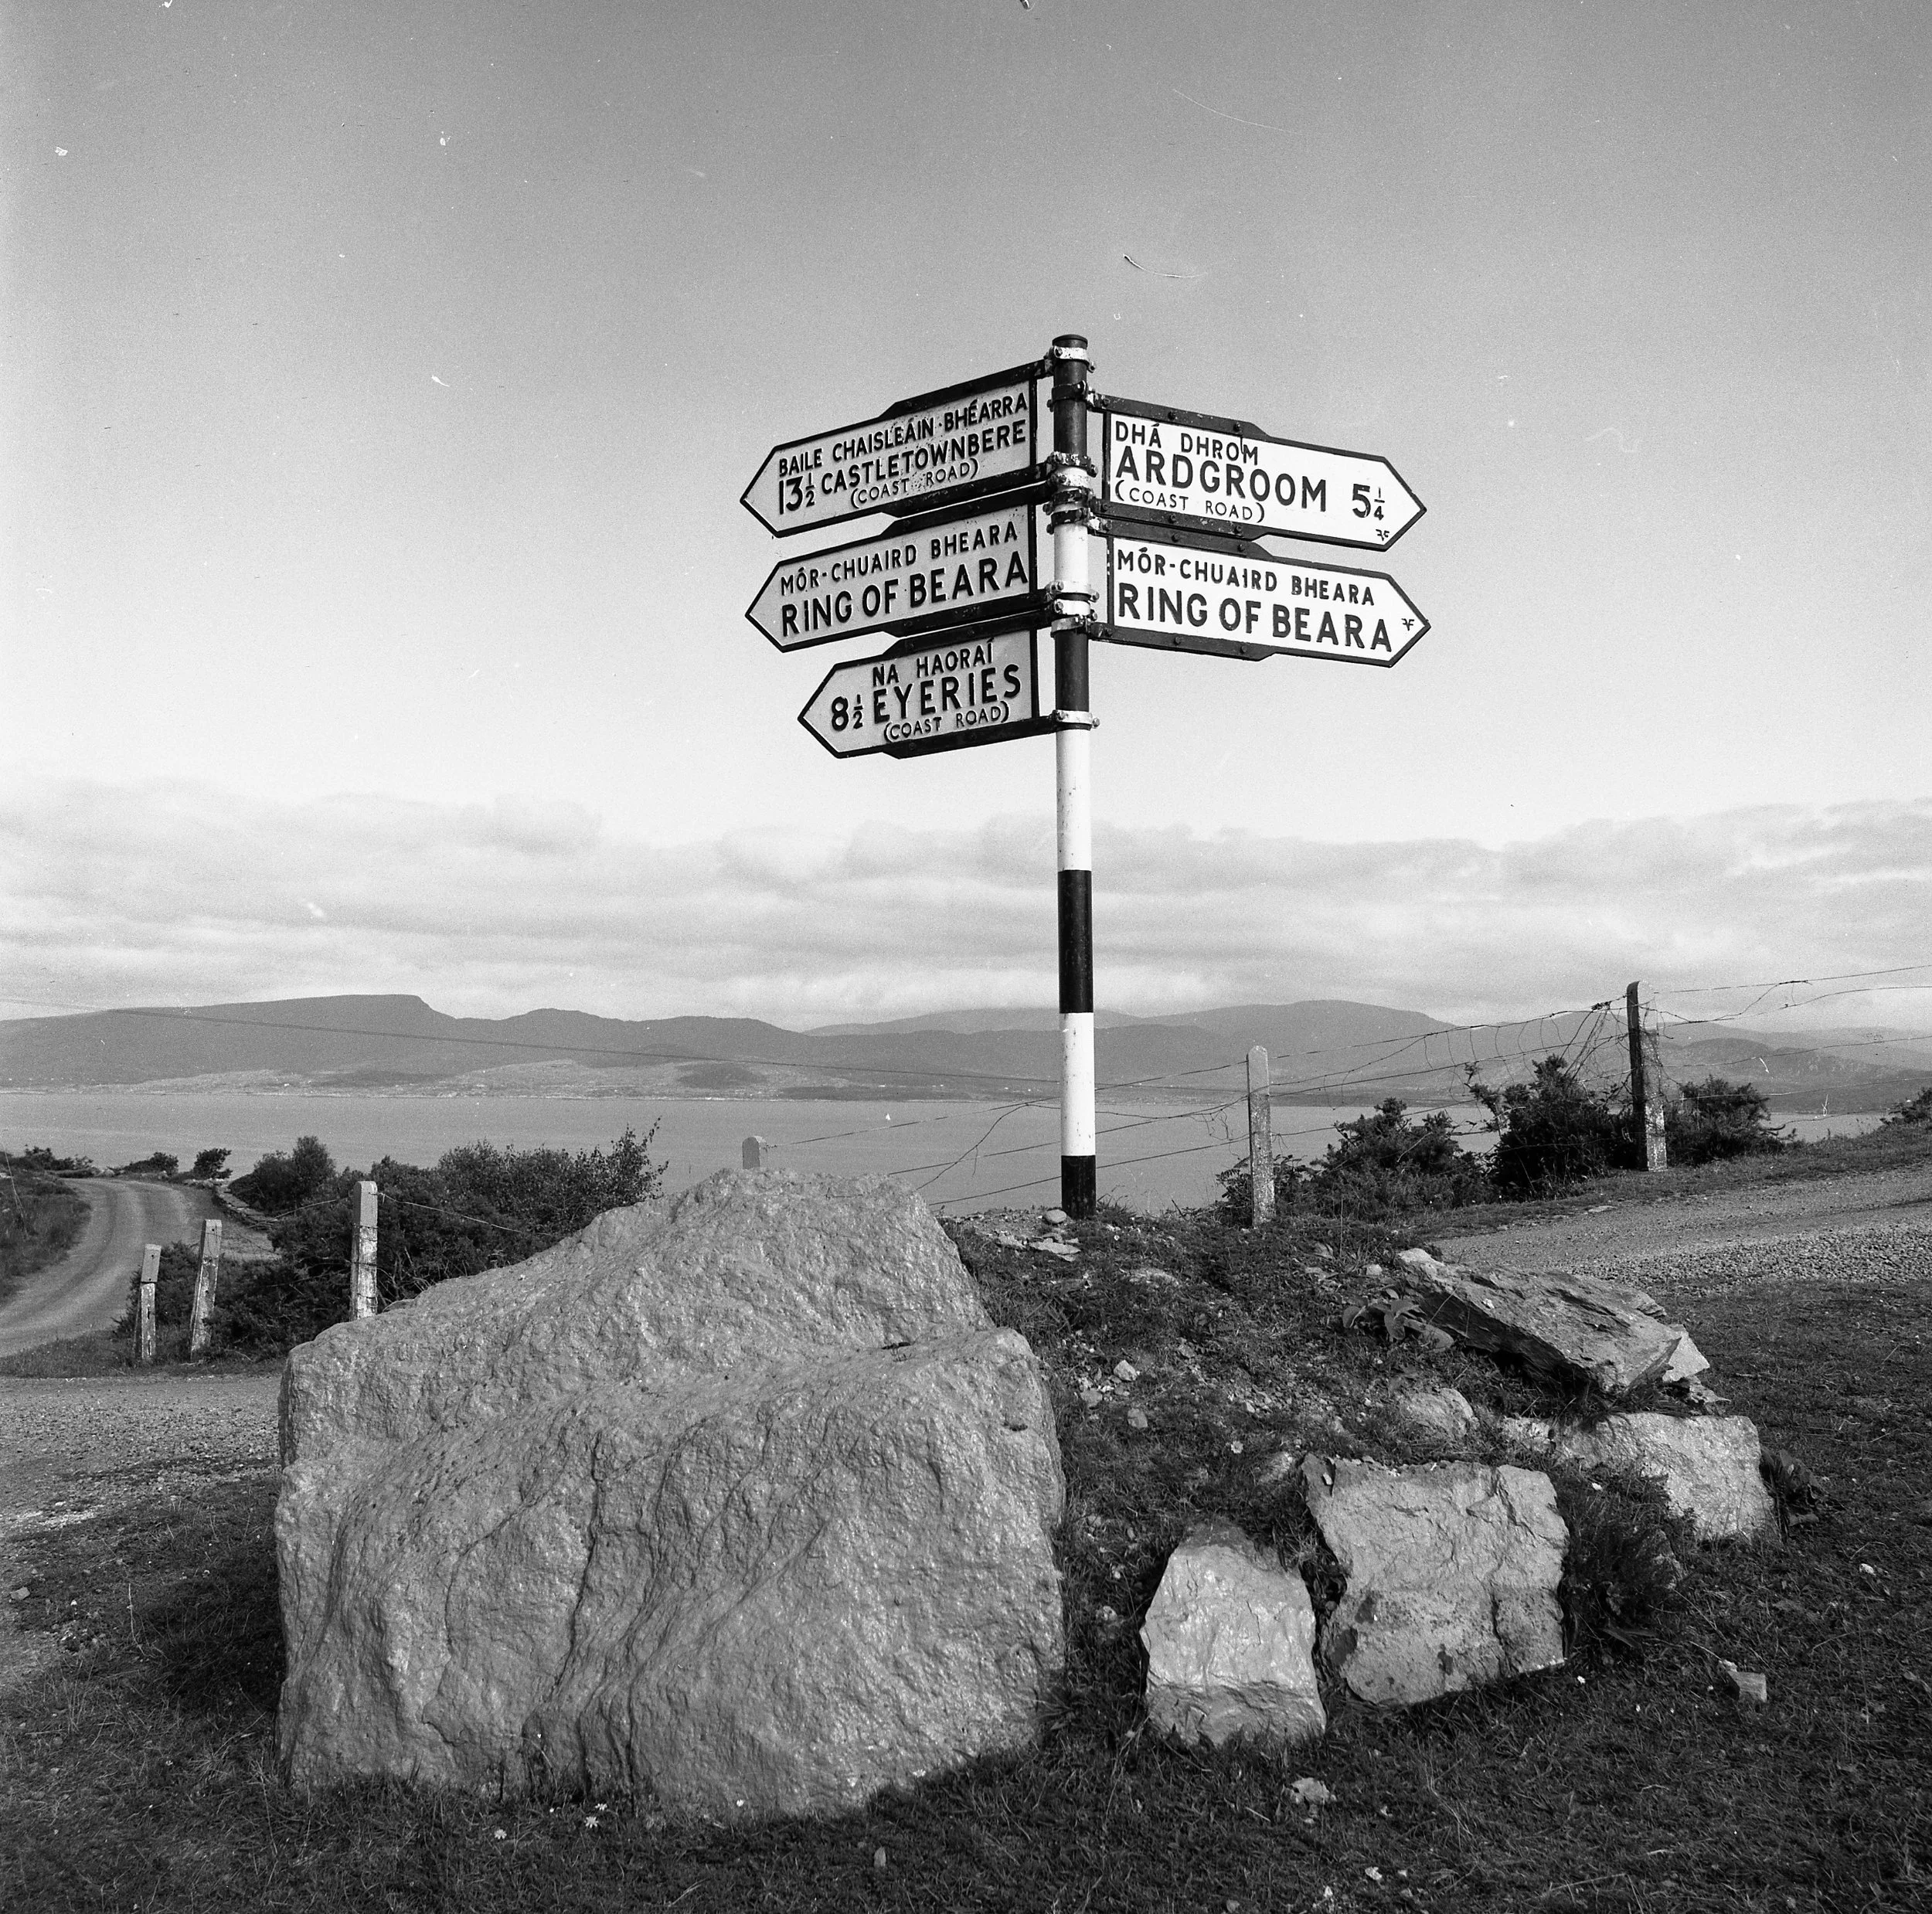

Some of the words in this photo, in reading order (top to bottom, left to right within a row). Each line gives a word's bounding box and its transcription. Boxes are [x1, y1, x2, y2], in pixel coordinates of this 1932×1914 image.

[779, 448, 822, 477] BAILE
[832, 417, 934, 461] CHAISLEÁIN
[944, 393, 1027, 431] BHÉARRA
[821, 420, 1026, 495] CASTLETOWNBERE
[1115, 421, 1162, 448] DHÁ
[1181, 433, 1258, 465] DHROM
[851, 478, 910, 508] (COAST
[926, 458, 978, 486] ROAD)
[1115, 445, 1326, 512] ARDGROOM
[1115, 479, 1189, 510] (COAST
[1206, 500, 1265, 524] ROAD)
[781, 545, 917, 596] MÓR-CHUAIRD
[931, 522, 1018, 559] BHEARA
[1117, 547, 1277, 592] MÓR-CHUAIRD
[1291, 576, 1375, 606] BHEARA
[781, 591, 852, 637] RING
[862, 579, 899, 617] OF
[910, 550, 1028, 608] BEARA
[1118, 583, 1207, 627] RING
[1219, 598, 1261, 634] OF
[1272, 604, 1392, 652] BEARA
[872, 664, 899, 687] NA
[917, 637, 995, 678] HAORAÍ
[873, 664, 1021, 724] EYERIES
[884, 716, 941, 742] (COAST
[957, 701, 1009, 727] ROAD)
